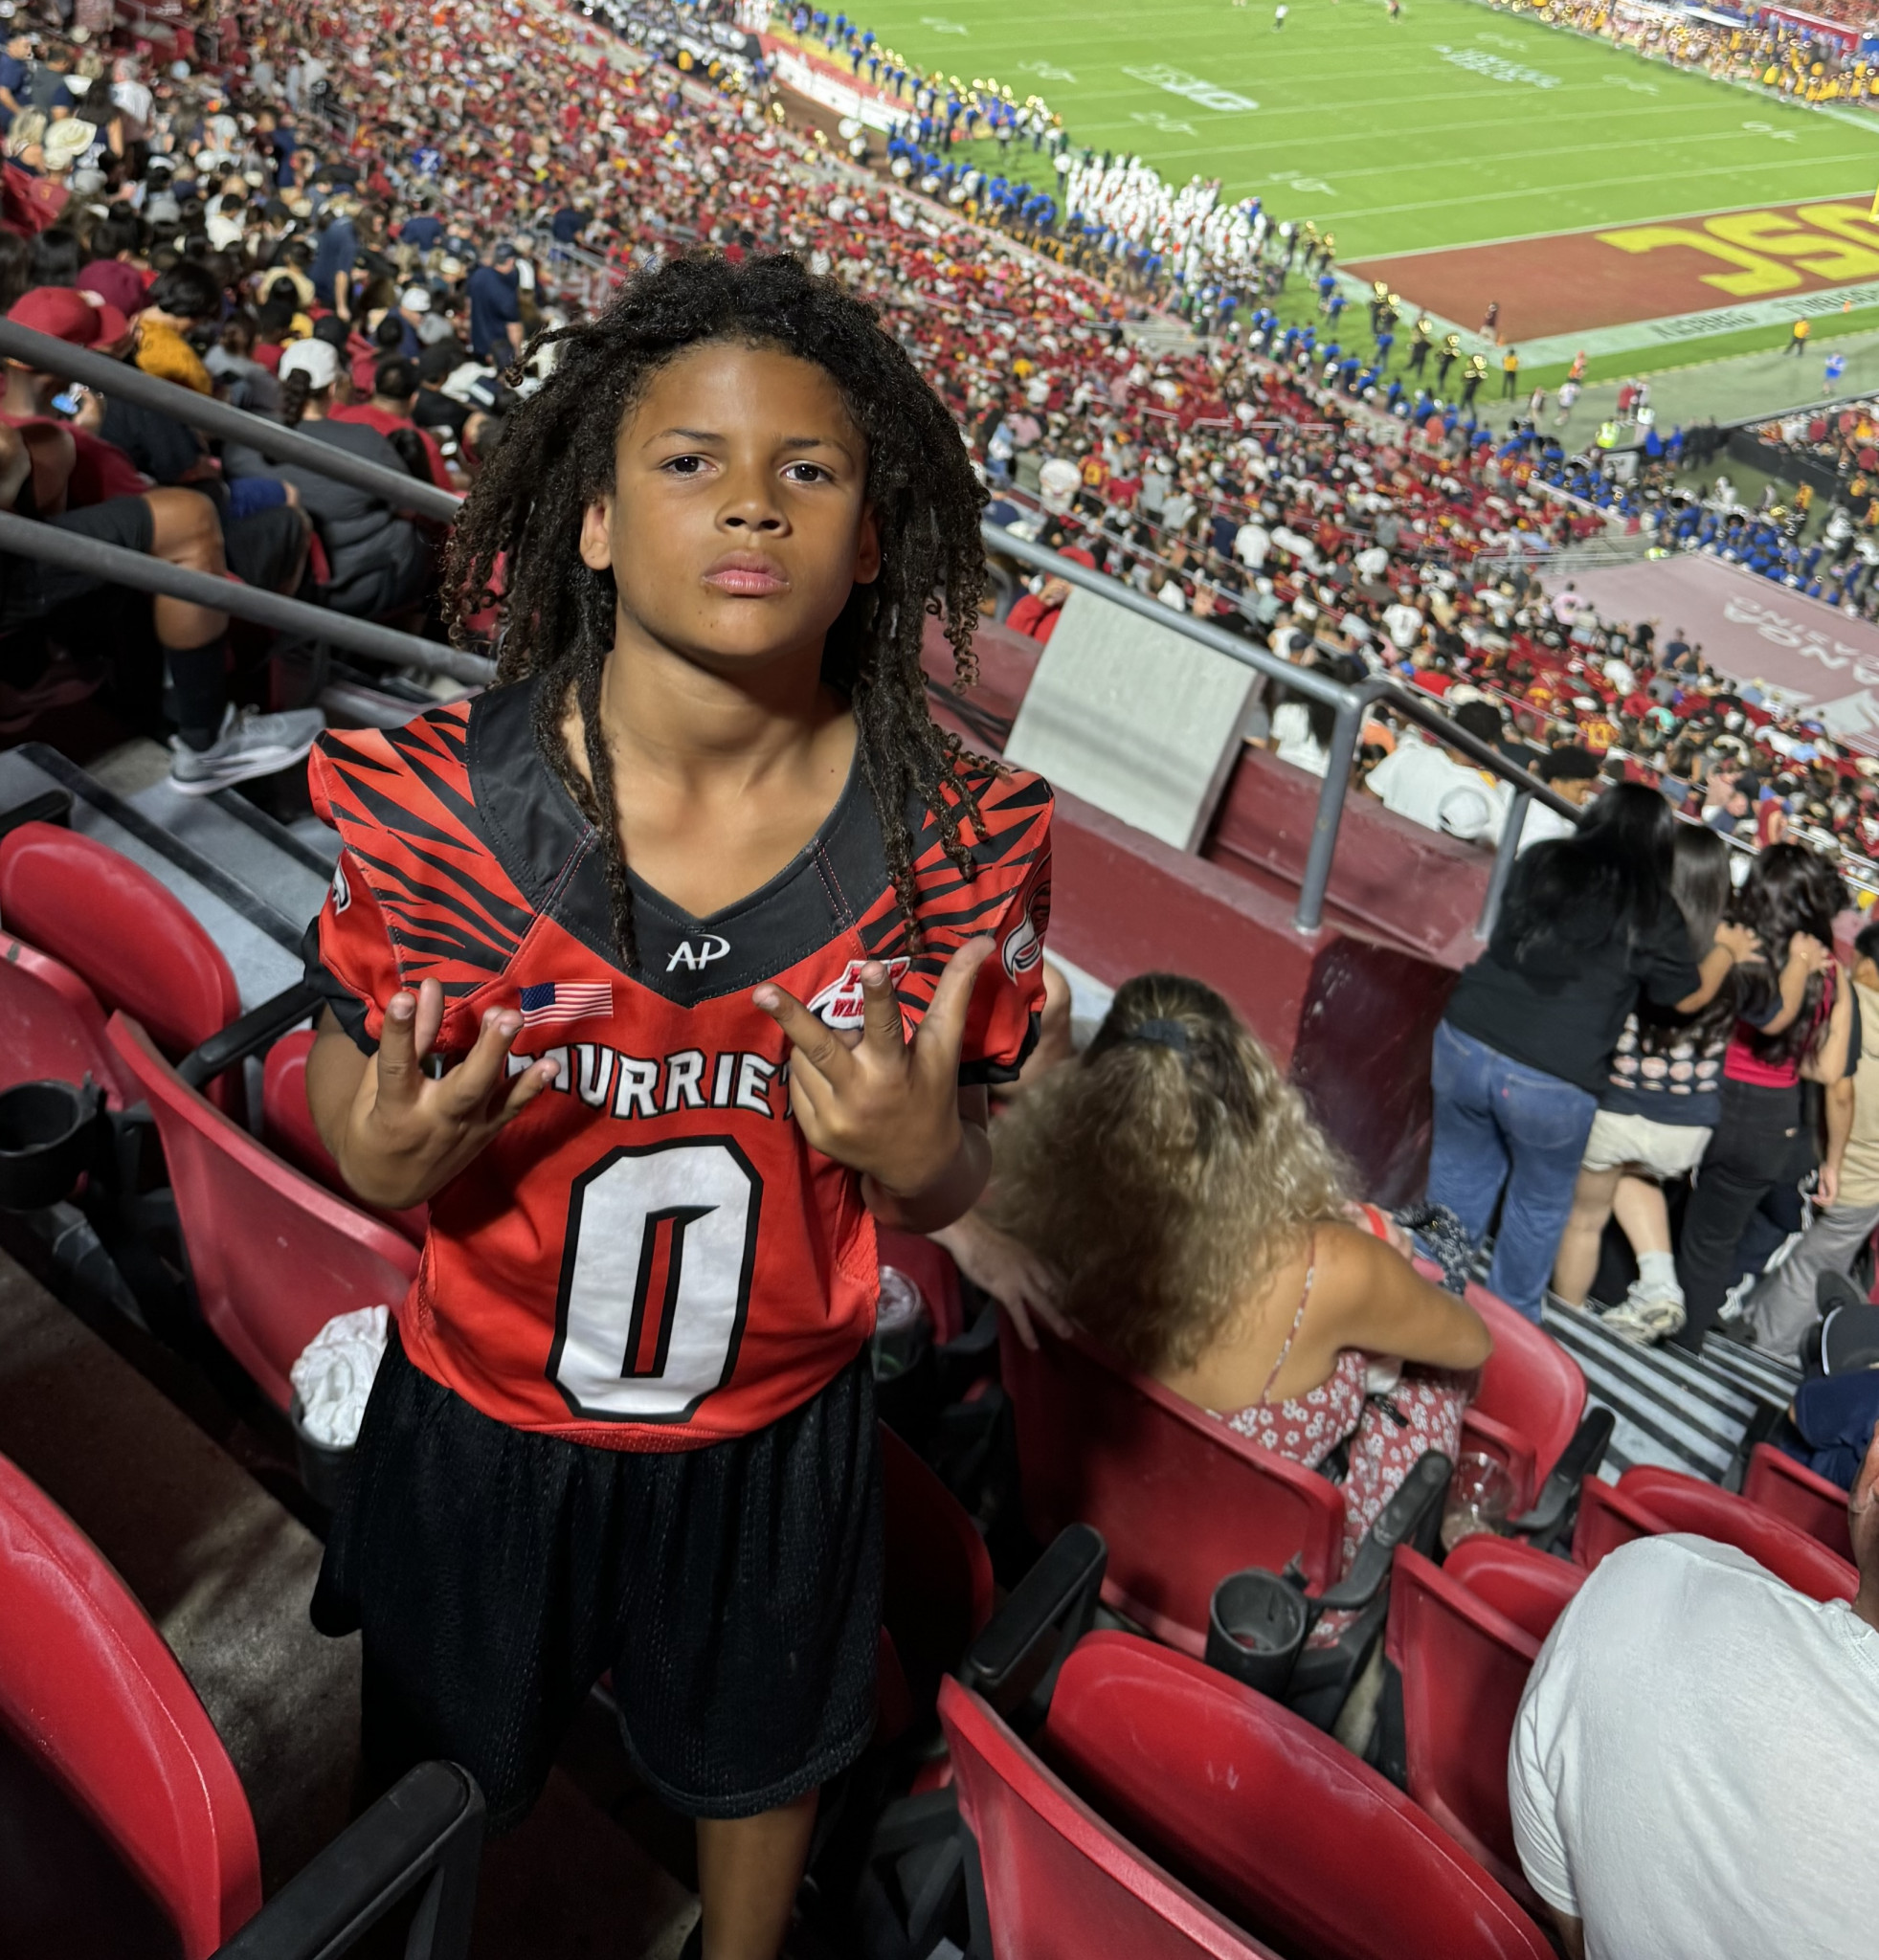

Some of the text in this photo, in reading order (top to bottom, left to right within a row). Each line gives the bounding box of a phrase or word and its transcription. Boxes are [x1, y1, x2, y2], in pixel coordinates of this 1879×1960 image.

[665, 934, 730, 972] AP
[505, 1042, 793, 1120] MURRIE
[546, 1134, 763, 1423] 0
